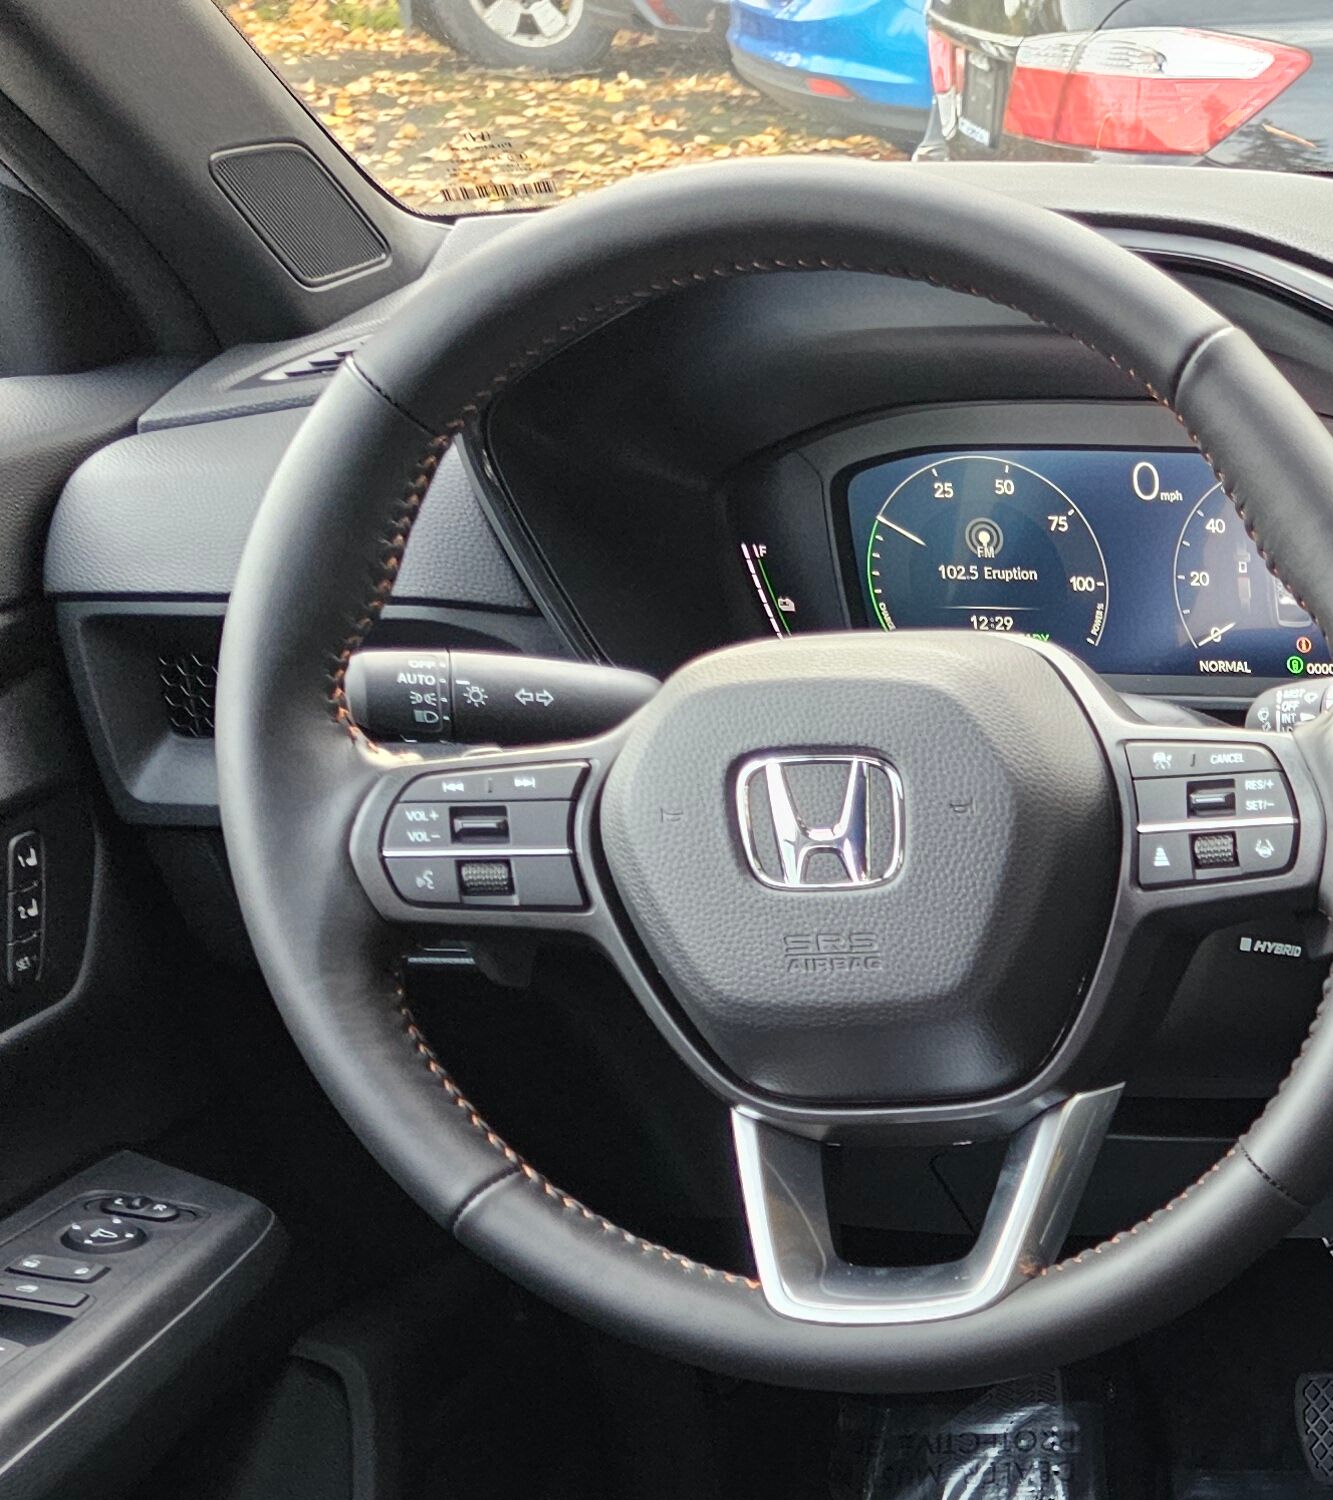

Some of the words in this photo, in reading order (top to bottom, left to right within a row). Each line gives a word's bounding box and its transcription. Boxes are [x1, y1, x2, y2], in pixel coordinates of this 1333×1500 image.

[994, 479, 1015, 495] 50
[1132, 461, 1160, 501] 0
[1160, 490, 1183, 502] mph
[933, 482, 954, 498] 25
[1047, 515, 1069, 532] 75
[1205, 518, 1226, 533] 40
[938, 565, 979, 580] 102.5
[984, 566, 1038, 583] Eruption
[1190, 571, 1210, 587] 20
[1069, 576, 1095, 592] 100
[969, 615, 1014, 631] 12:29
[1199, 660, 1252, 674] NORMAL
[397, 672, 436, 686] AUTO
[1281, 712, 1297, 724] INT
[1209, 752, 1245, 765] CANCEL
[1253, 939, 1302, 957] HYBRID
